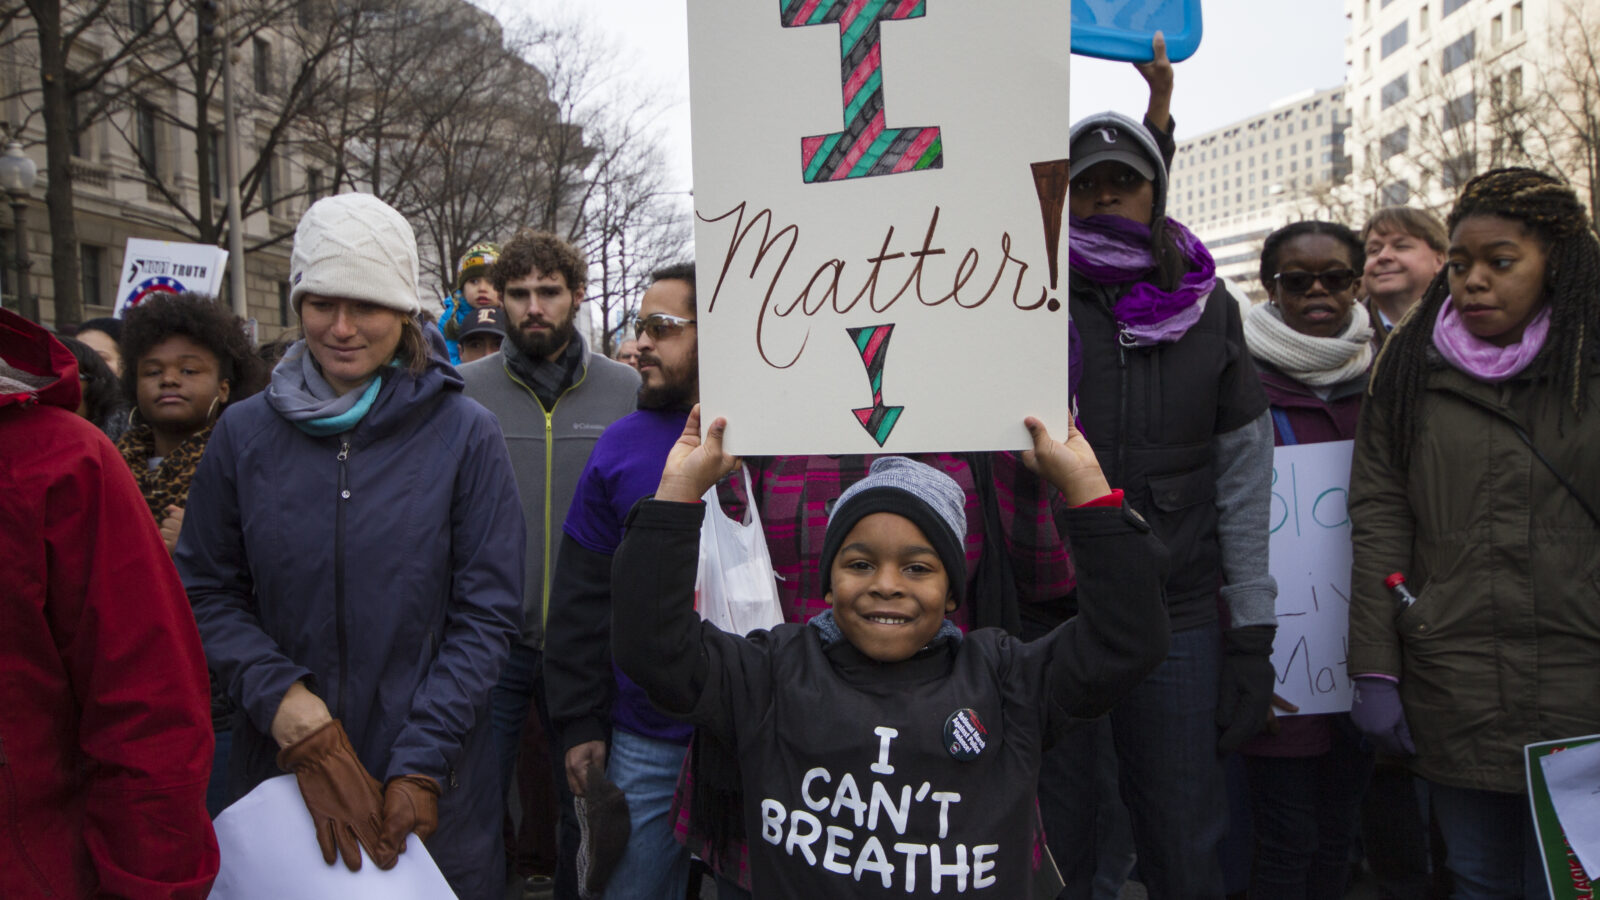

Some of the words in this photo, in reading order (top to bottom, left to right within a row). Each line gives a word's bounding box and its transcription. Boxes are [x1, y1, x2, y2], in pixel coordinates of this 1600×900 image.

[778, 0, 943, 184] I
[172, 264, 207, 278] TRUTH
[695, 159, 1070, 369] Matter!
[870, 726, 898, 775] I
[801, 767, 961, 839] CAN'T
[761, 798, 999, 894] BREATHE
